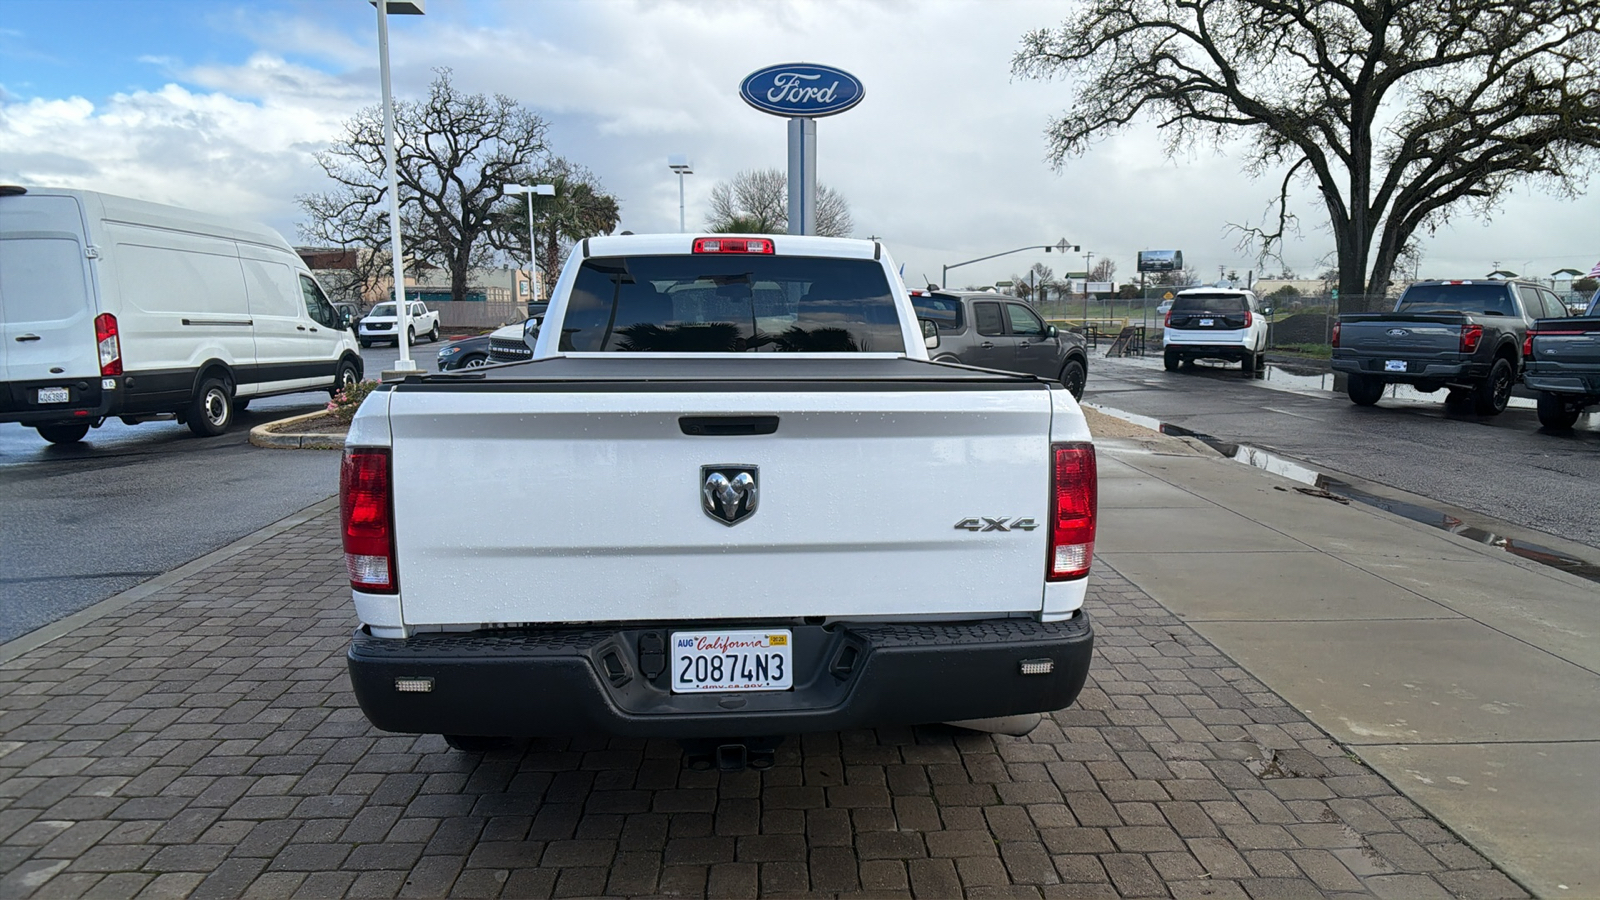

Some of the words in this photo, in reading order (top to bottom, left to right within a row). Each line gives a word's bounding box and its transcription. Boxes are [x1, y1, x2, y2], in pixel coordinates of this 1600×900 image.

[767, 72, 839, 103] Ford
[677, 639, 694, 648] AUG
[696, 636, 770, 653] California
[680, 653, 784, 683] 20874N3
